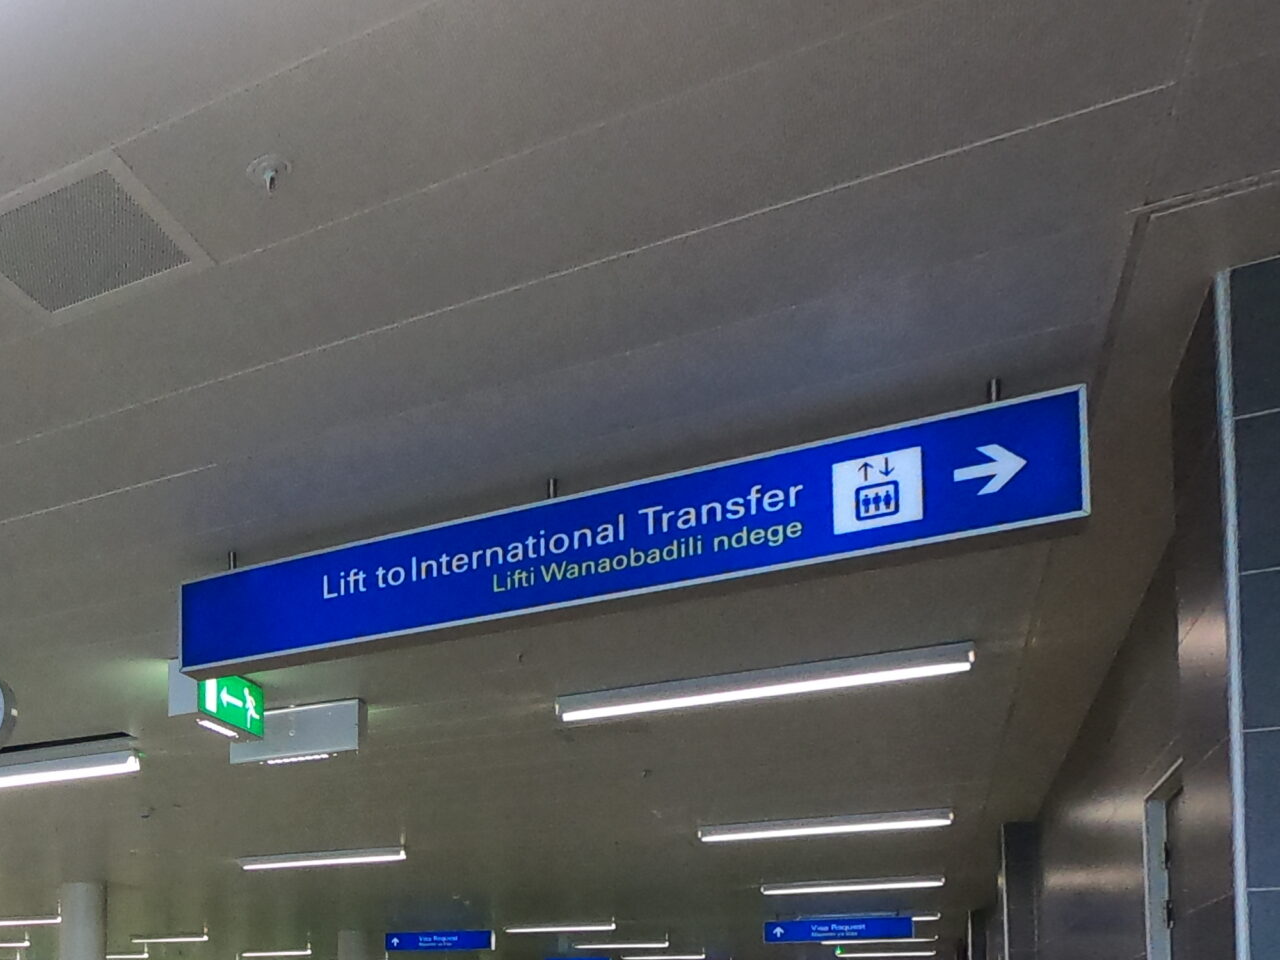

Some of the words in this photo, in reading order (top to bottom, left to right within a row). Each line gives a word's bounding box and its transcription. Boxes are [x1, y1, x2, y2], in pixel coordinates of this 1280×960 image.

[322, 571, 367, 600] Lift
[375, 564, 406, 589] to
[411, 513, 626, 582] International
[638, 480, 805, 537] Transfer
[492, 565, 535, 593] Lifti
[540, 536, 704, 583] Wanaobadili
[713, 519, 803, 551] ndege
[810, 924, 829, 932] Visa
[830, 923, 867, 933] Request
